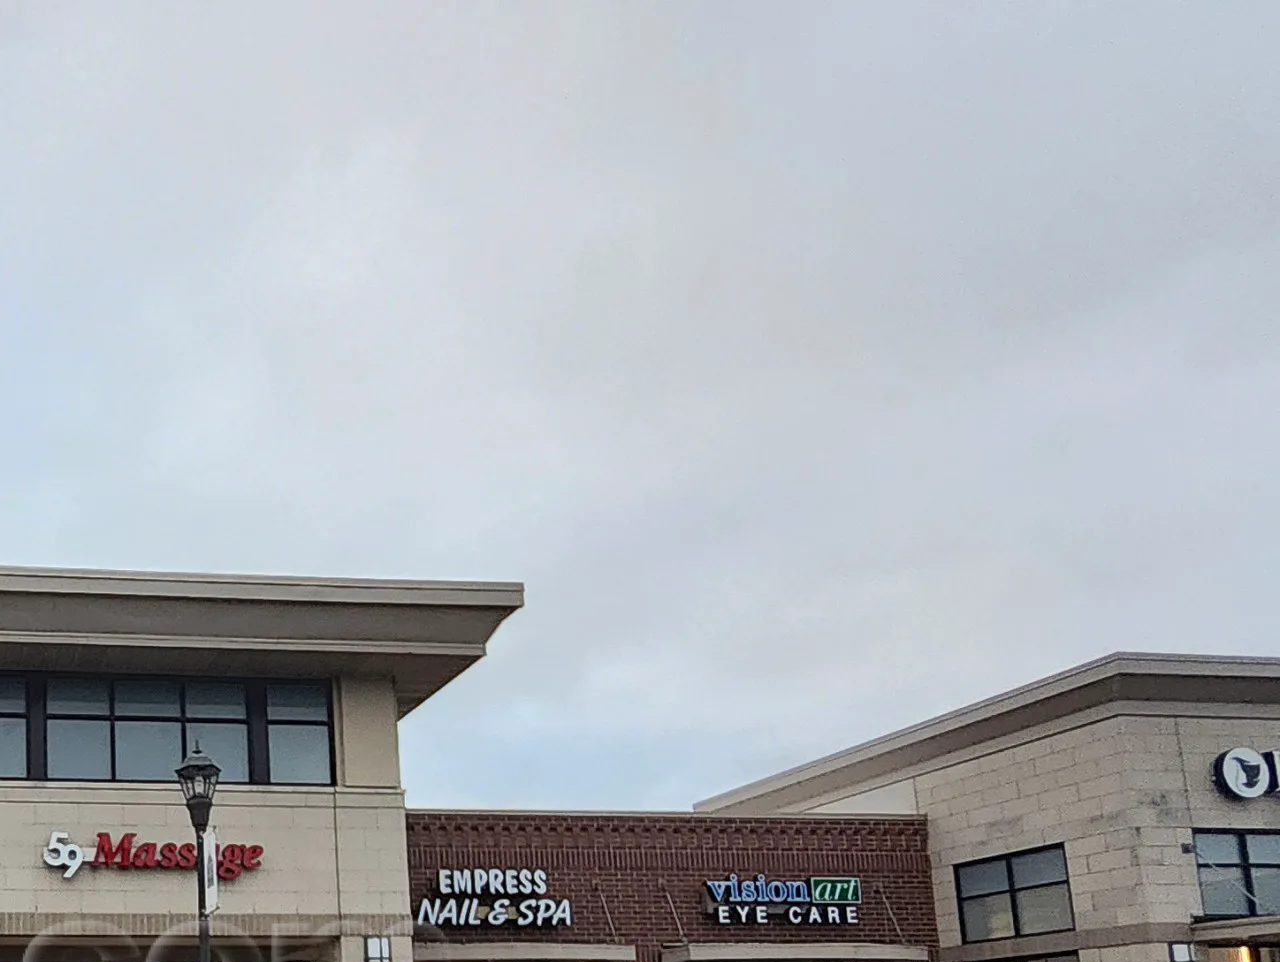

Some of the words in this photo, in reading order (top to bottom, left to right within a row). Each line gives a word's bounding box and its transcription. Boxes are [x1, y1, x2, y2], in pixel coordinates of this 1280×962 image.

[43, 831, 84, 878] 59
[88, 832, 264, 881] Massge
[438, 868, 548, 895] EMPRESS
[706, 873, 811, 903] vision
[814, 879, 858, 901] art
[417, 898, 481, 926] NAIL
[488, 898, 510, 925] &
[517, 898, 572, 926] SPA
[718, 905, 769, 924] EYE
[788, 906, 859, 924] CARE
